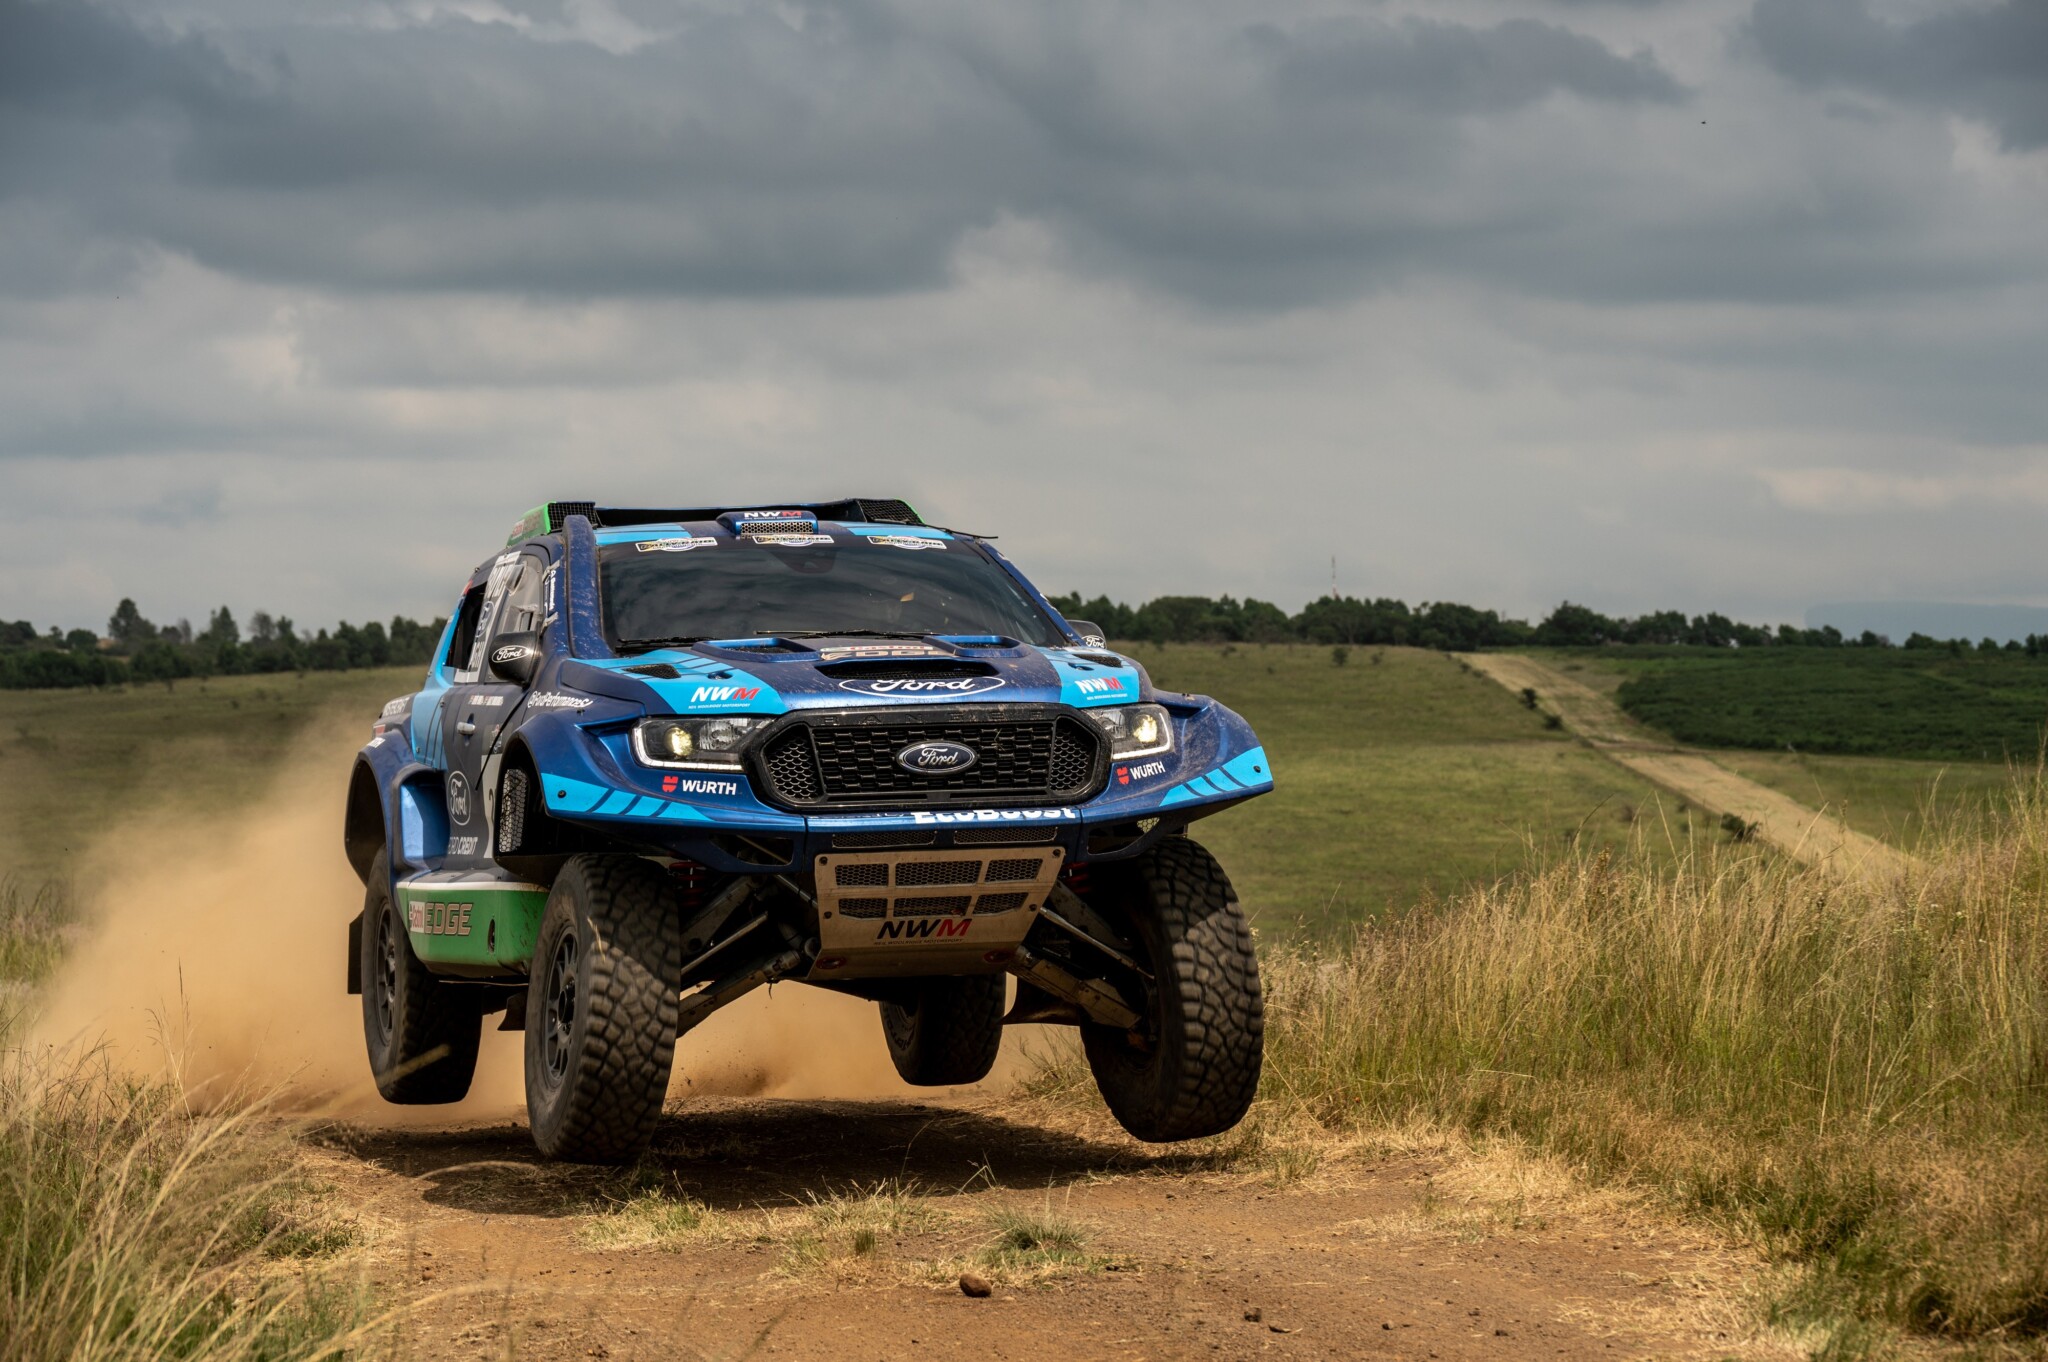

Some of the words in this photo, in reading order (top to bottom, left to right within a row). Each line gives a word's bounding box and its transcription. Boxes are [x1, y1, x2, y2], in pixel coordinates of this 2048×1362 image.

[1085, 635, 1105, 649] Ford
[496, 648, 522, 661] Ford
[870, 678, 976, 692] Ford
[1074, 676, 1125, 694] NWM
[690, 686, 761, 703] NWM
[917, 747, 959, 766] Ford
[450, 778, 467, 816] Ford
[424, 902, 473, 936] EDGE
[877, 918, 973, 940] NWM
